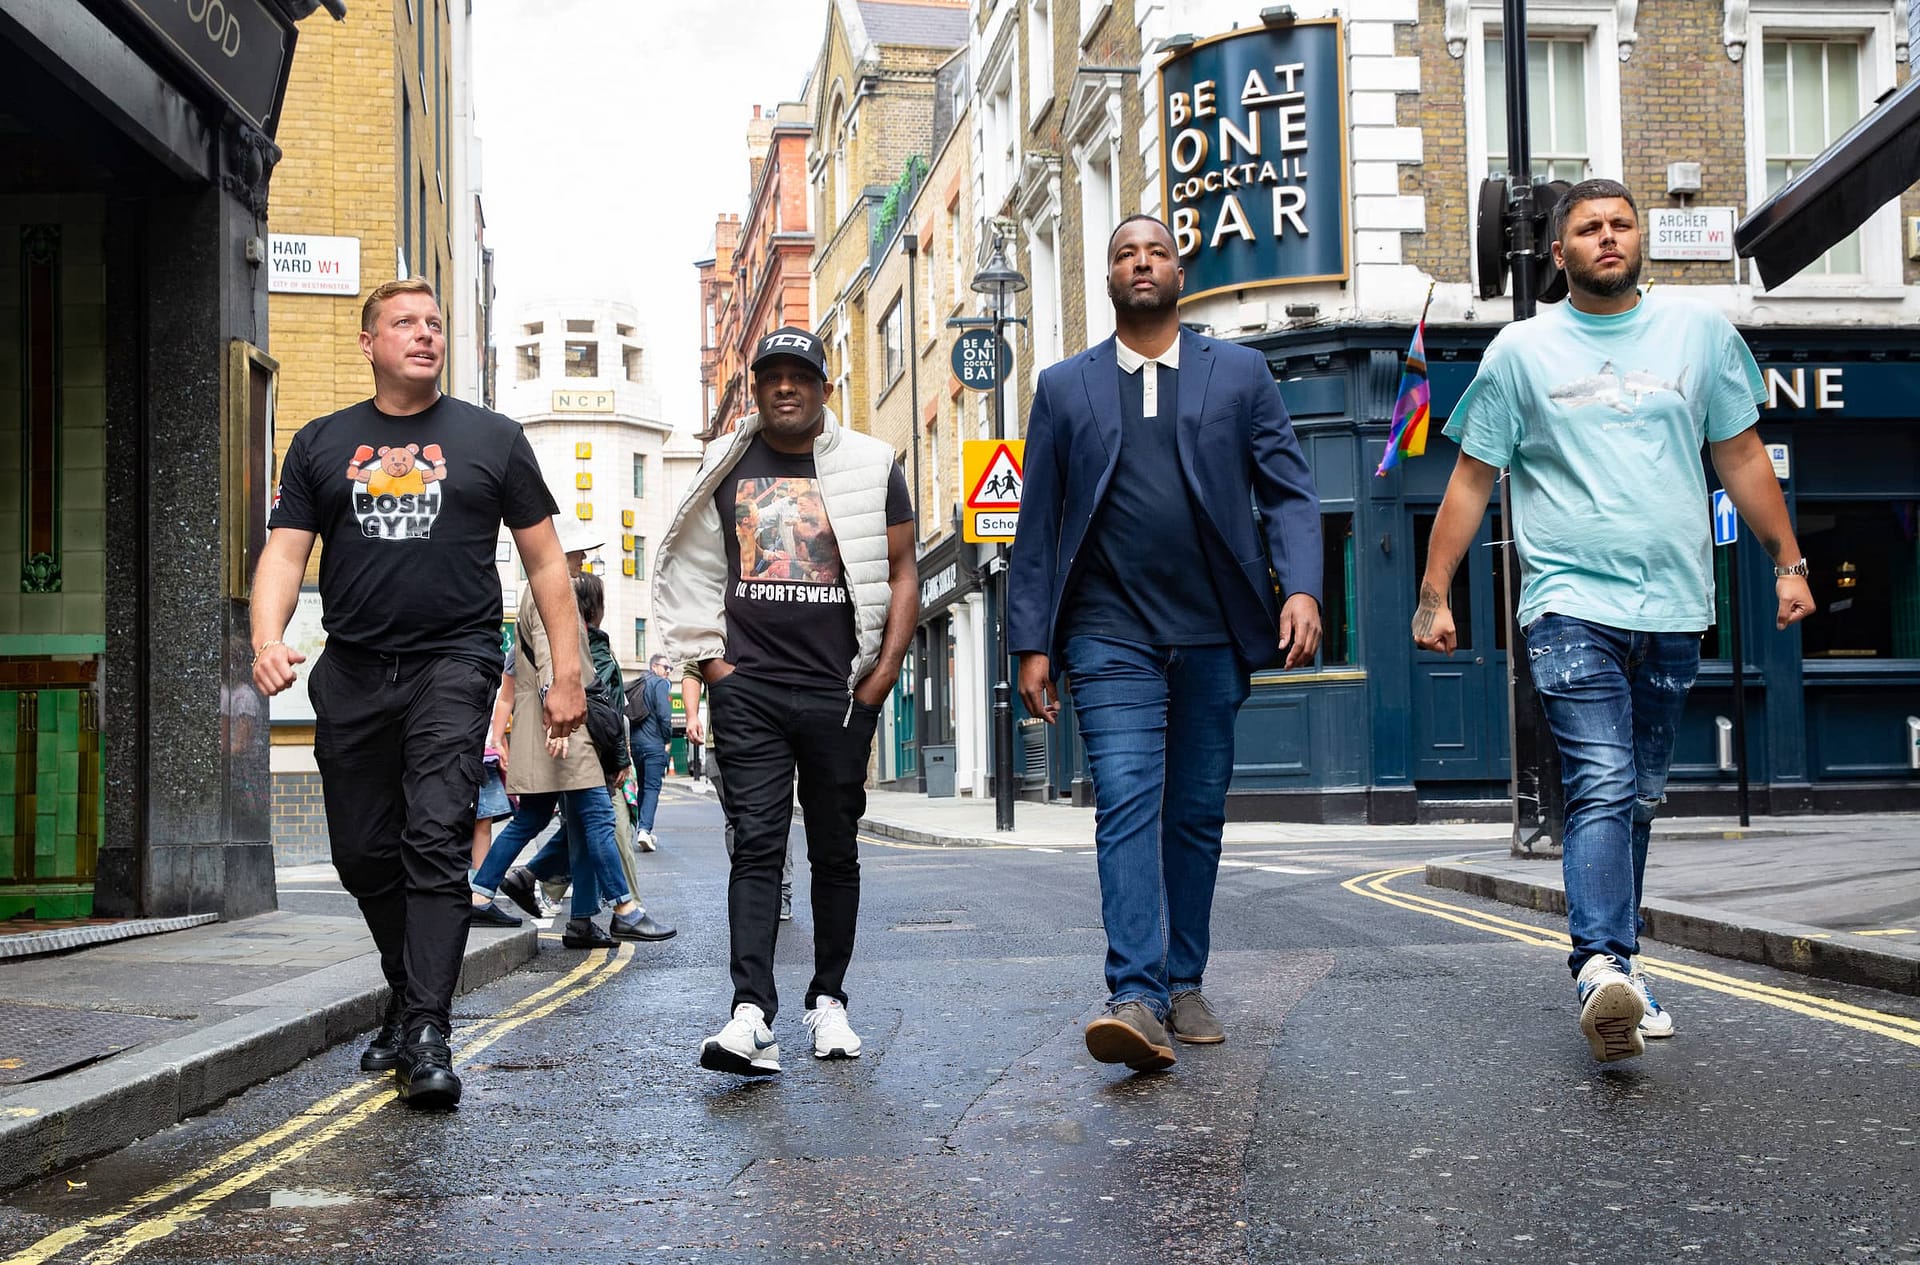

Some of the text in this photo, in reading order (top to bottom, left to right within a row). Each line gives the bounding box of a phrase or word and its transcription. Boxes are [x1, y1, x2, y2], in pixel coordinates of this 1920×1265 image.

[186, 0, 241, 57] OOD
[1170, 63, 1305, 127] BE AT
[1171, 105, 1307, 173] ONE
[1172, 158, 1307, 202] COCKTAIL
[1173, 186, 1308, 257] BAR
[1659, 215, 1708, 227] ARCHER
[1659, 230, 1725, 243] STREET W1
[273, 241, 307, 255] HAM
[273, 258, 339, 274] YARD W1
[963, 338, 995, 348] BE A
[1764, 368, 1844, 409] NE
[559, 395, 607, 408] NCP
[355, 493, 440, 515] BOSH
[362, 515, 430, 538] GYM
[982, 518, 1019, 529] Scho
[749, 583, 846, 603] SPORTSWEAR
